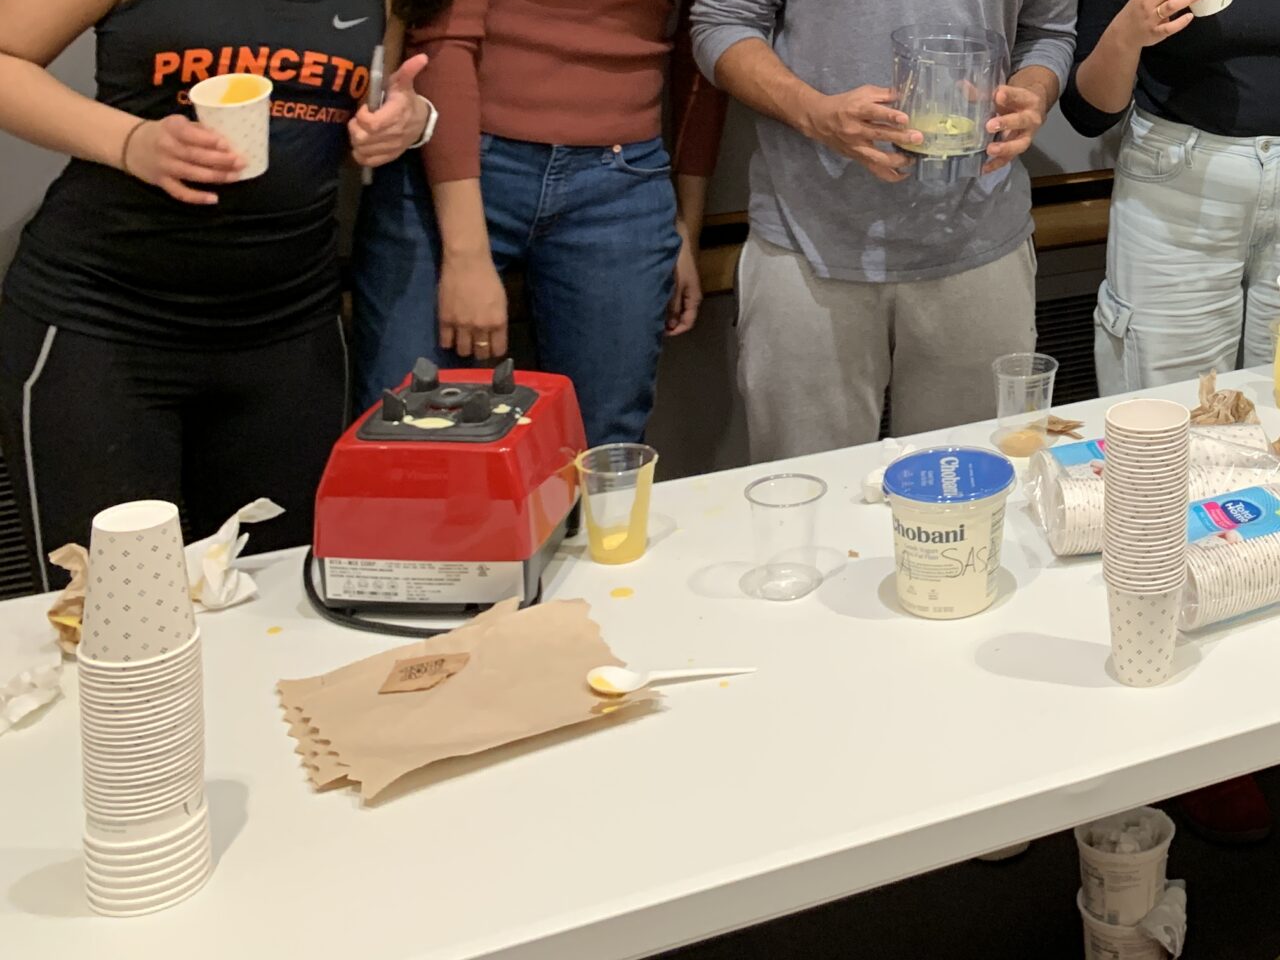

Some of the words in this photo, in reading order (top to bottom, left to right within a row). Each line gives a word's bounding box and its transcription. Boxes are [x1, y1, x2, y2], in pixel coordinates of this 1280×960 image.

[153, 47, 370, 99] PRINCETO
[268, 100, 351, 124] ECREATIO
[940, 456, 960, 497] Chobani
[1224, 502, 1250, 523] Home
[1235, 501, 1257, 520] Total
